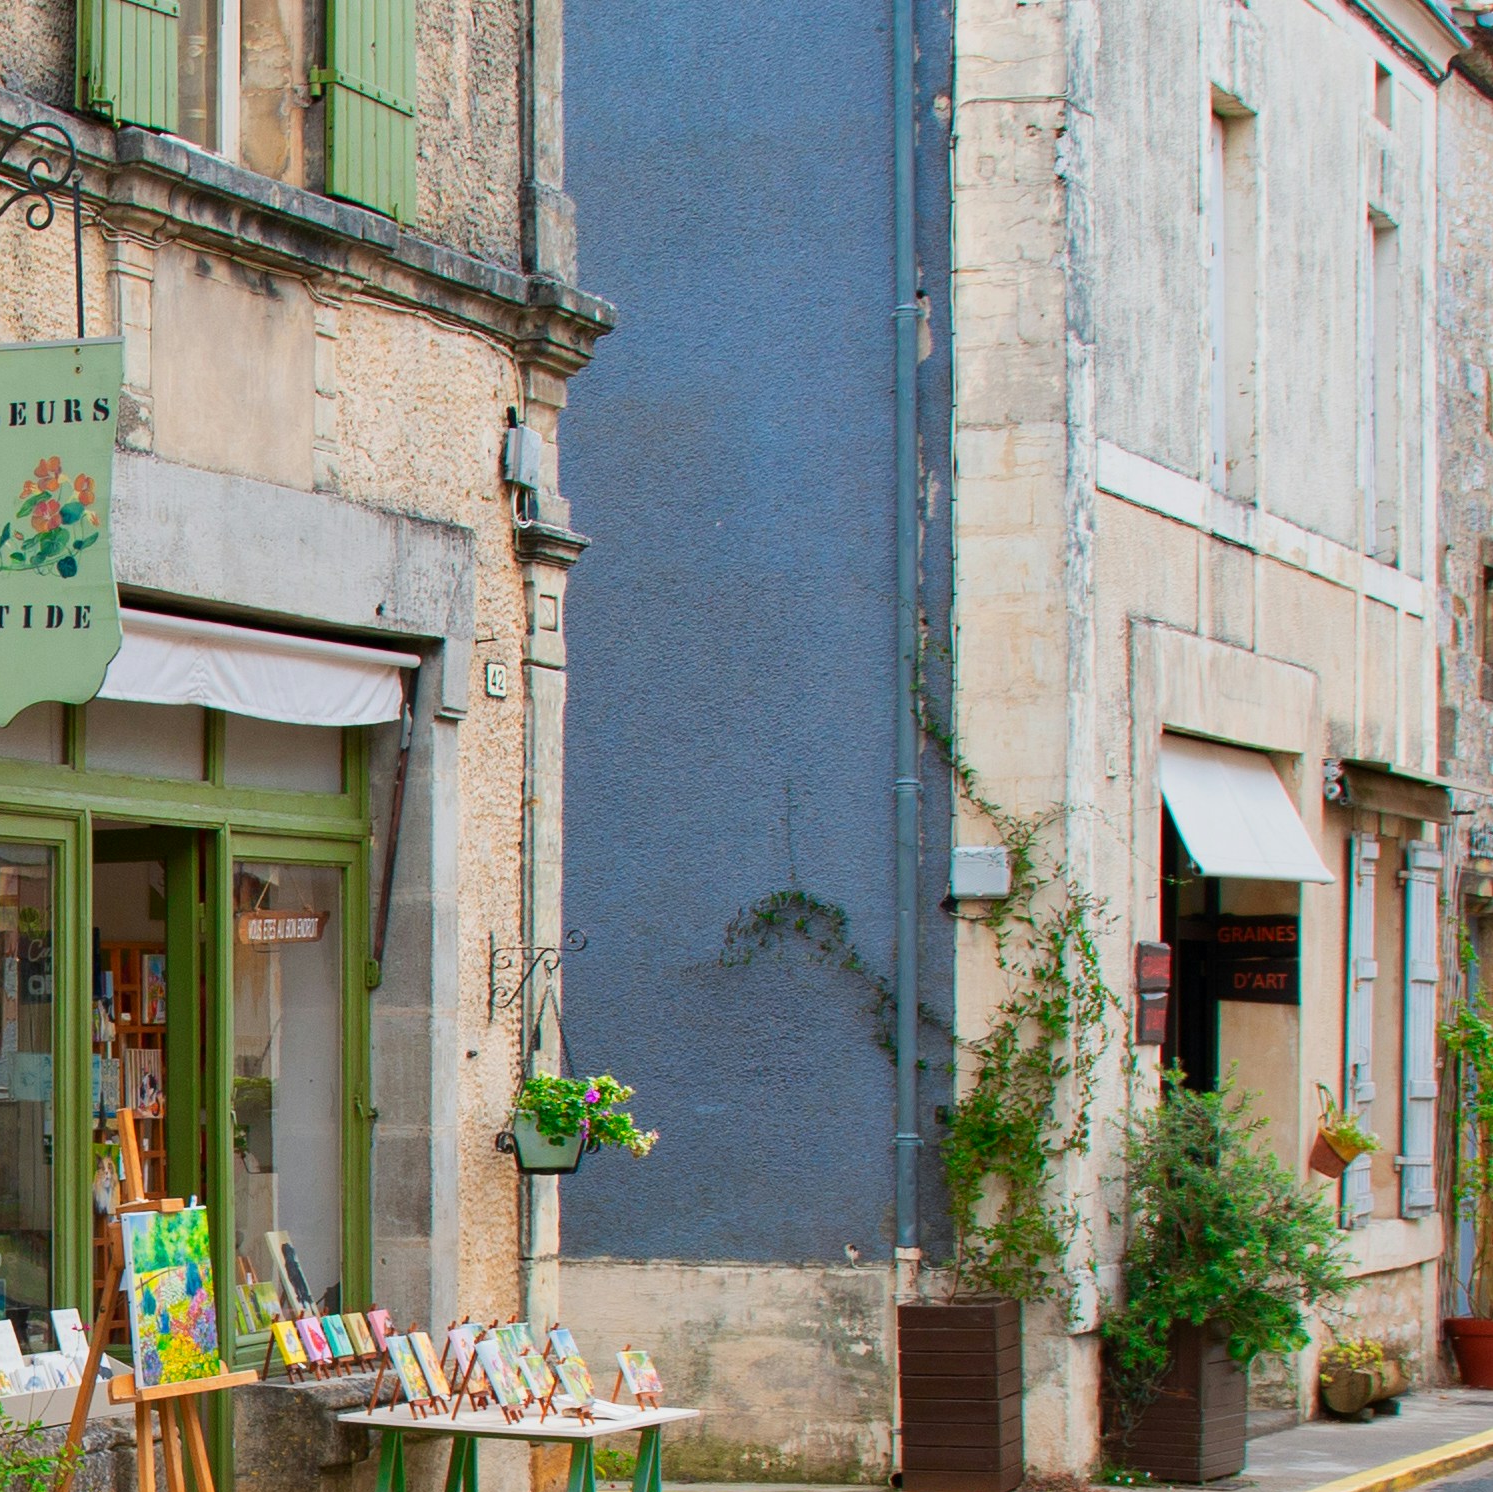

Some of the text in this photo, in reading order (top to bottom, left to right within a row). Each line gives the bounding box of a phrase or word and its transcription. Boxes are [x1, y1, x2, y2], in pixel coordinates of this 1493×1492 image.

[491, 669, 505, 691] 42
[1218, 927, 1297, 942] GRAINES
[1234, 973, 1287, 989] D'ART
